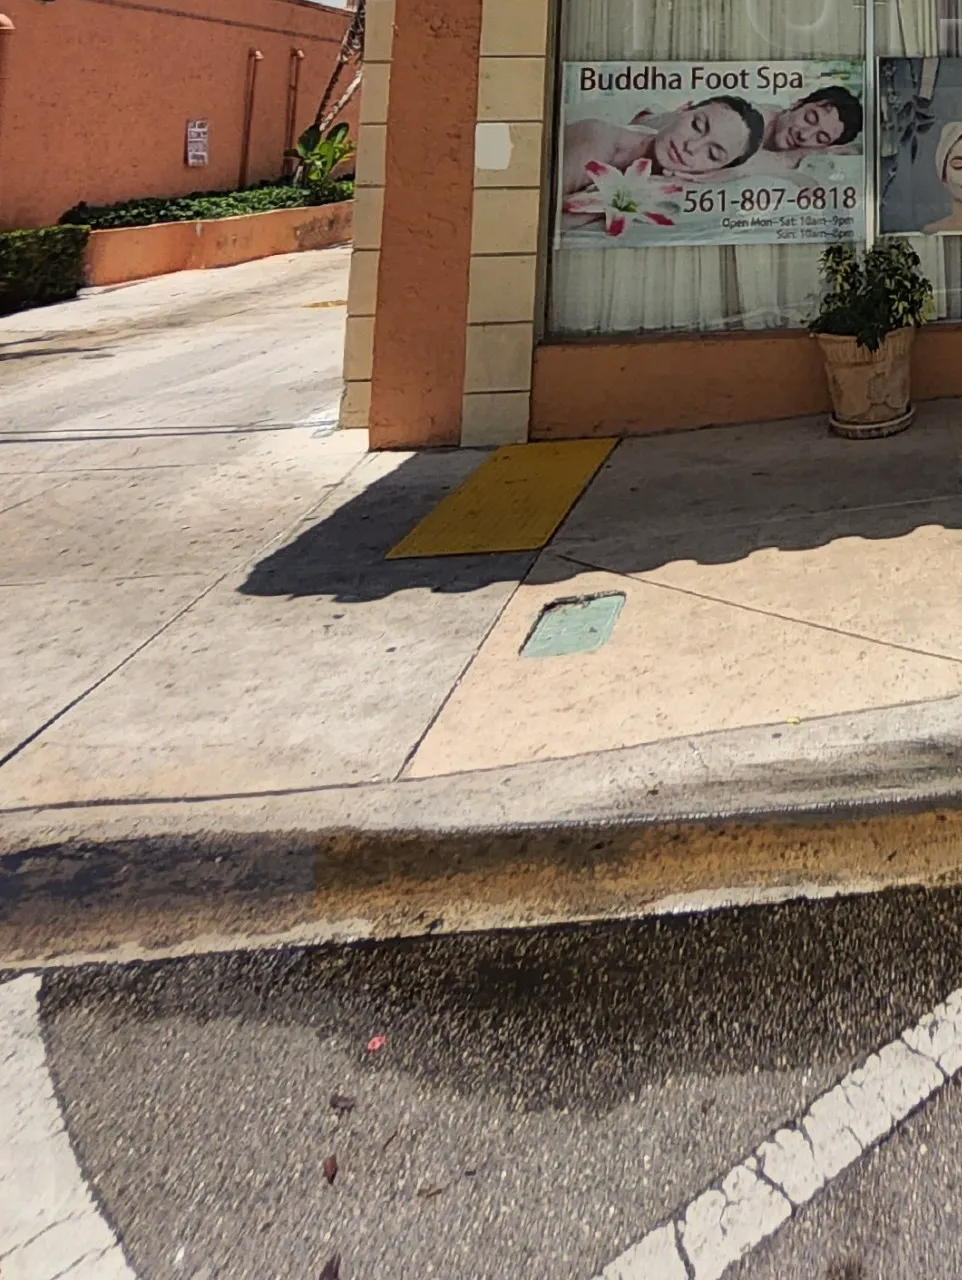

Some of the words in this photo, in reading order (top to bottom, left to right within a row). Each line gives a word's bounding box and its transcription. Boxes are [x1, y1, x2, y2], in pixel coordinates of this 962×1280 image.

[579, 66, 683, 91] Buddha
[690, 66, 751, 90] Foot
[756, 66, 804, 96] Spa
[682, 186, 857, 213] 561-807-6818
[721, 217, 748, 230] Open
